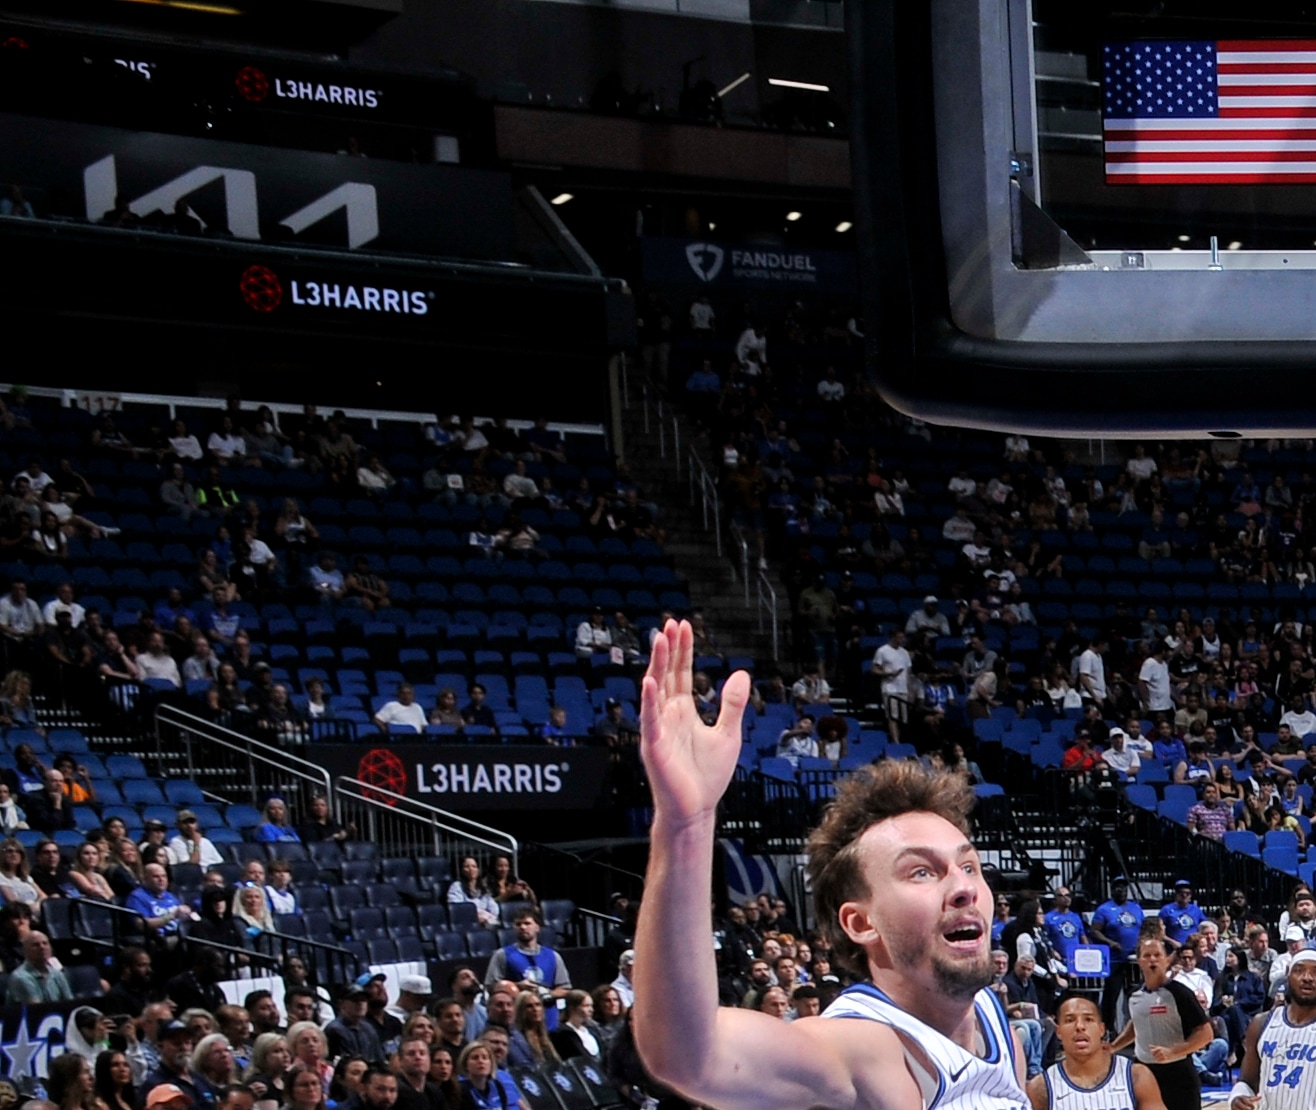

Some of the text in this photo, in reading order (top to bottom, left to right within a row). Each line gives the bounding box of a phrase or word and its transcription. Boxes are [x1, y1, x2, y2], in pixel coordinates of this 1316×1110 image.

[275, 77, 378, 108] L3HARRIS
[731, 250, 816, 271] FANDUEL
[291, 280, 428, 315] L3HARRIS
[417, 764, 562, 793] L3HARRIS
[1266, 1063, 1304, 1089] 34
